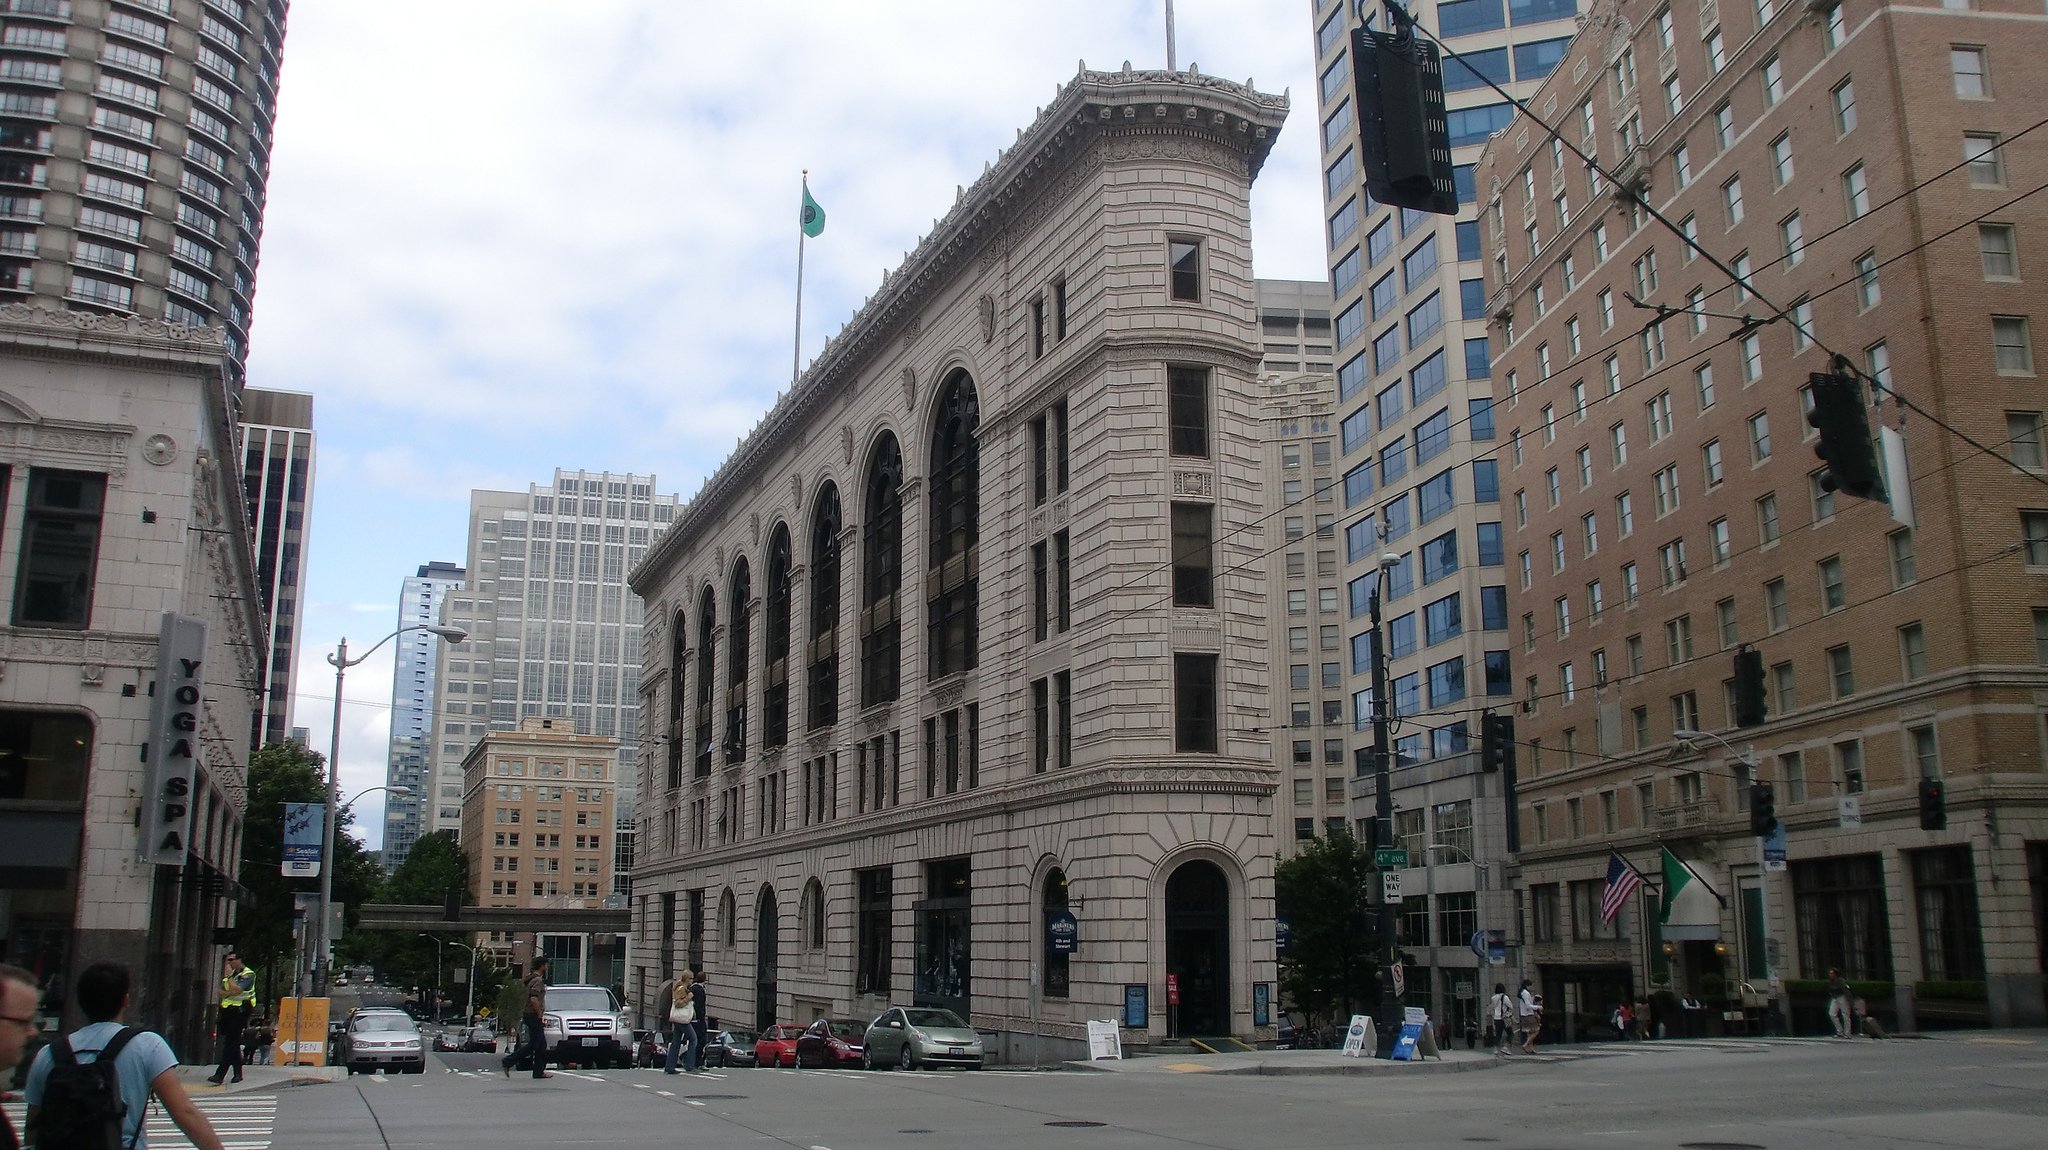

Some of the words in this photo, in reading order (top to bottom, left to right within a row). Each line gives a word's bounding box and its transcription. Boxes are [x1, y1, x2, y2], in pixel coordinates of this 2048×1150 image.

[169, 658, 202, 758] YOGA
[159, 776, 189, 850] SPA
[1385, 874, 1400, 882] ONE
[282, 1020, 323, 1029] CODOS
[1345, 1039, 1360, 1050] OPEN
